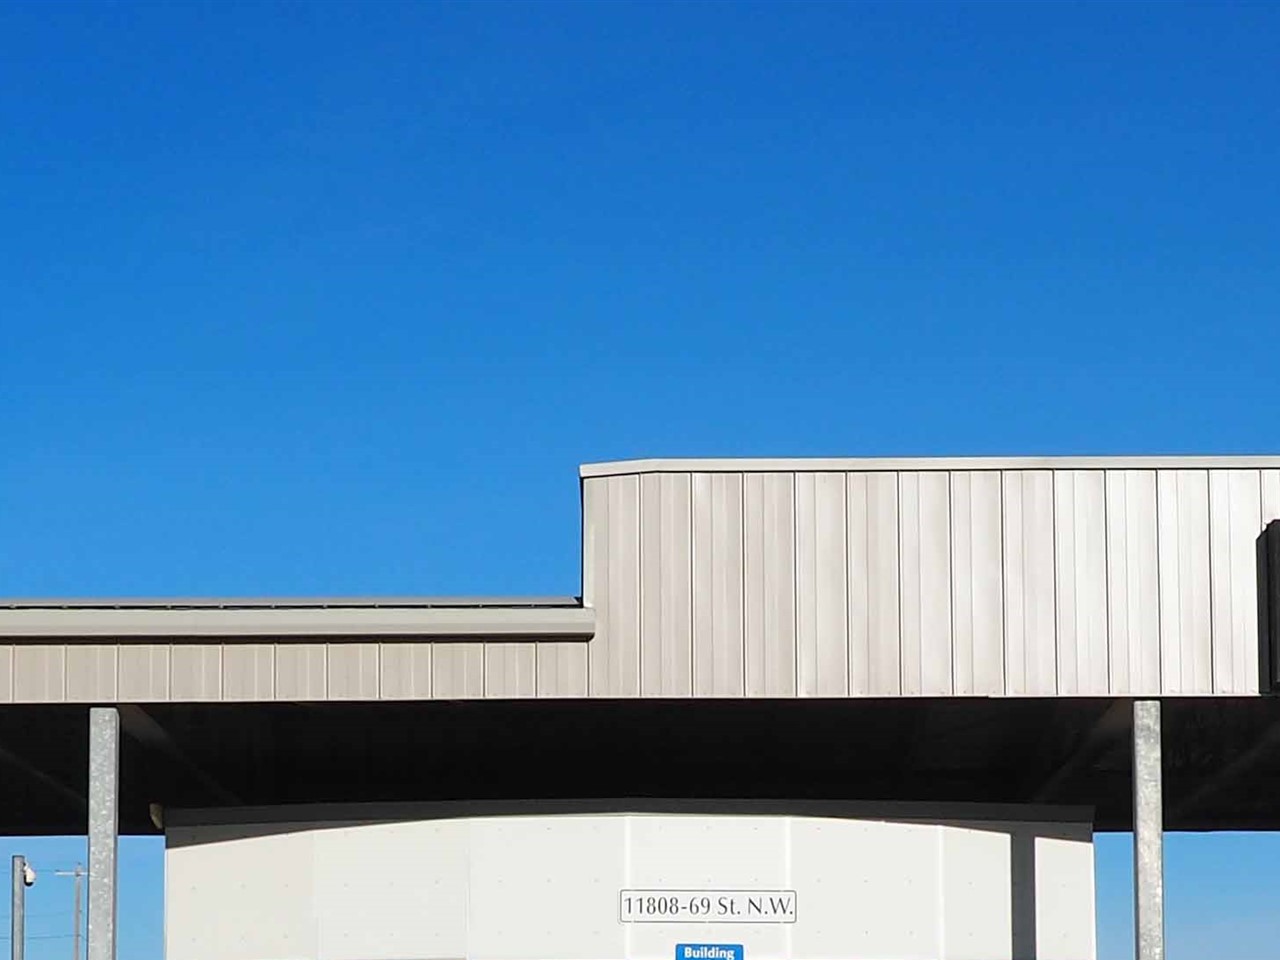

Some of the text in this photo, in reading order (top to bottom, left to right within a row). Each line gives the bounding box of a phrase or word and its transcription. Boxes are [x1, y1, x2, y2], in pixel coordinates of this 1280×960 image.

[624, 897, 793, 915] 11808-69 St. N.W.
[684, 947, 735, 960] Building
